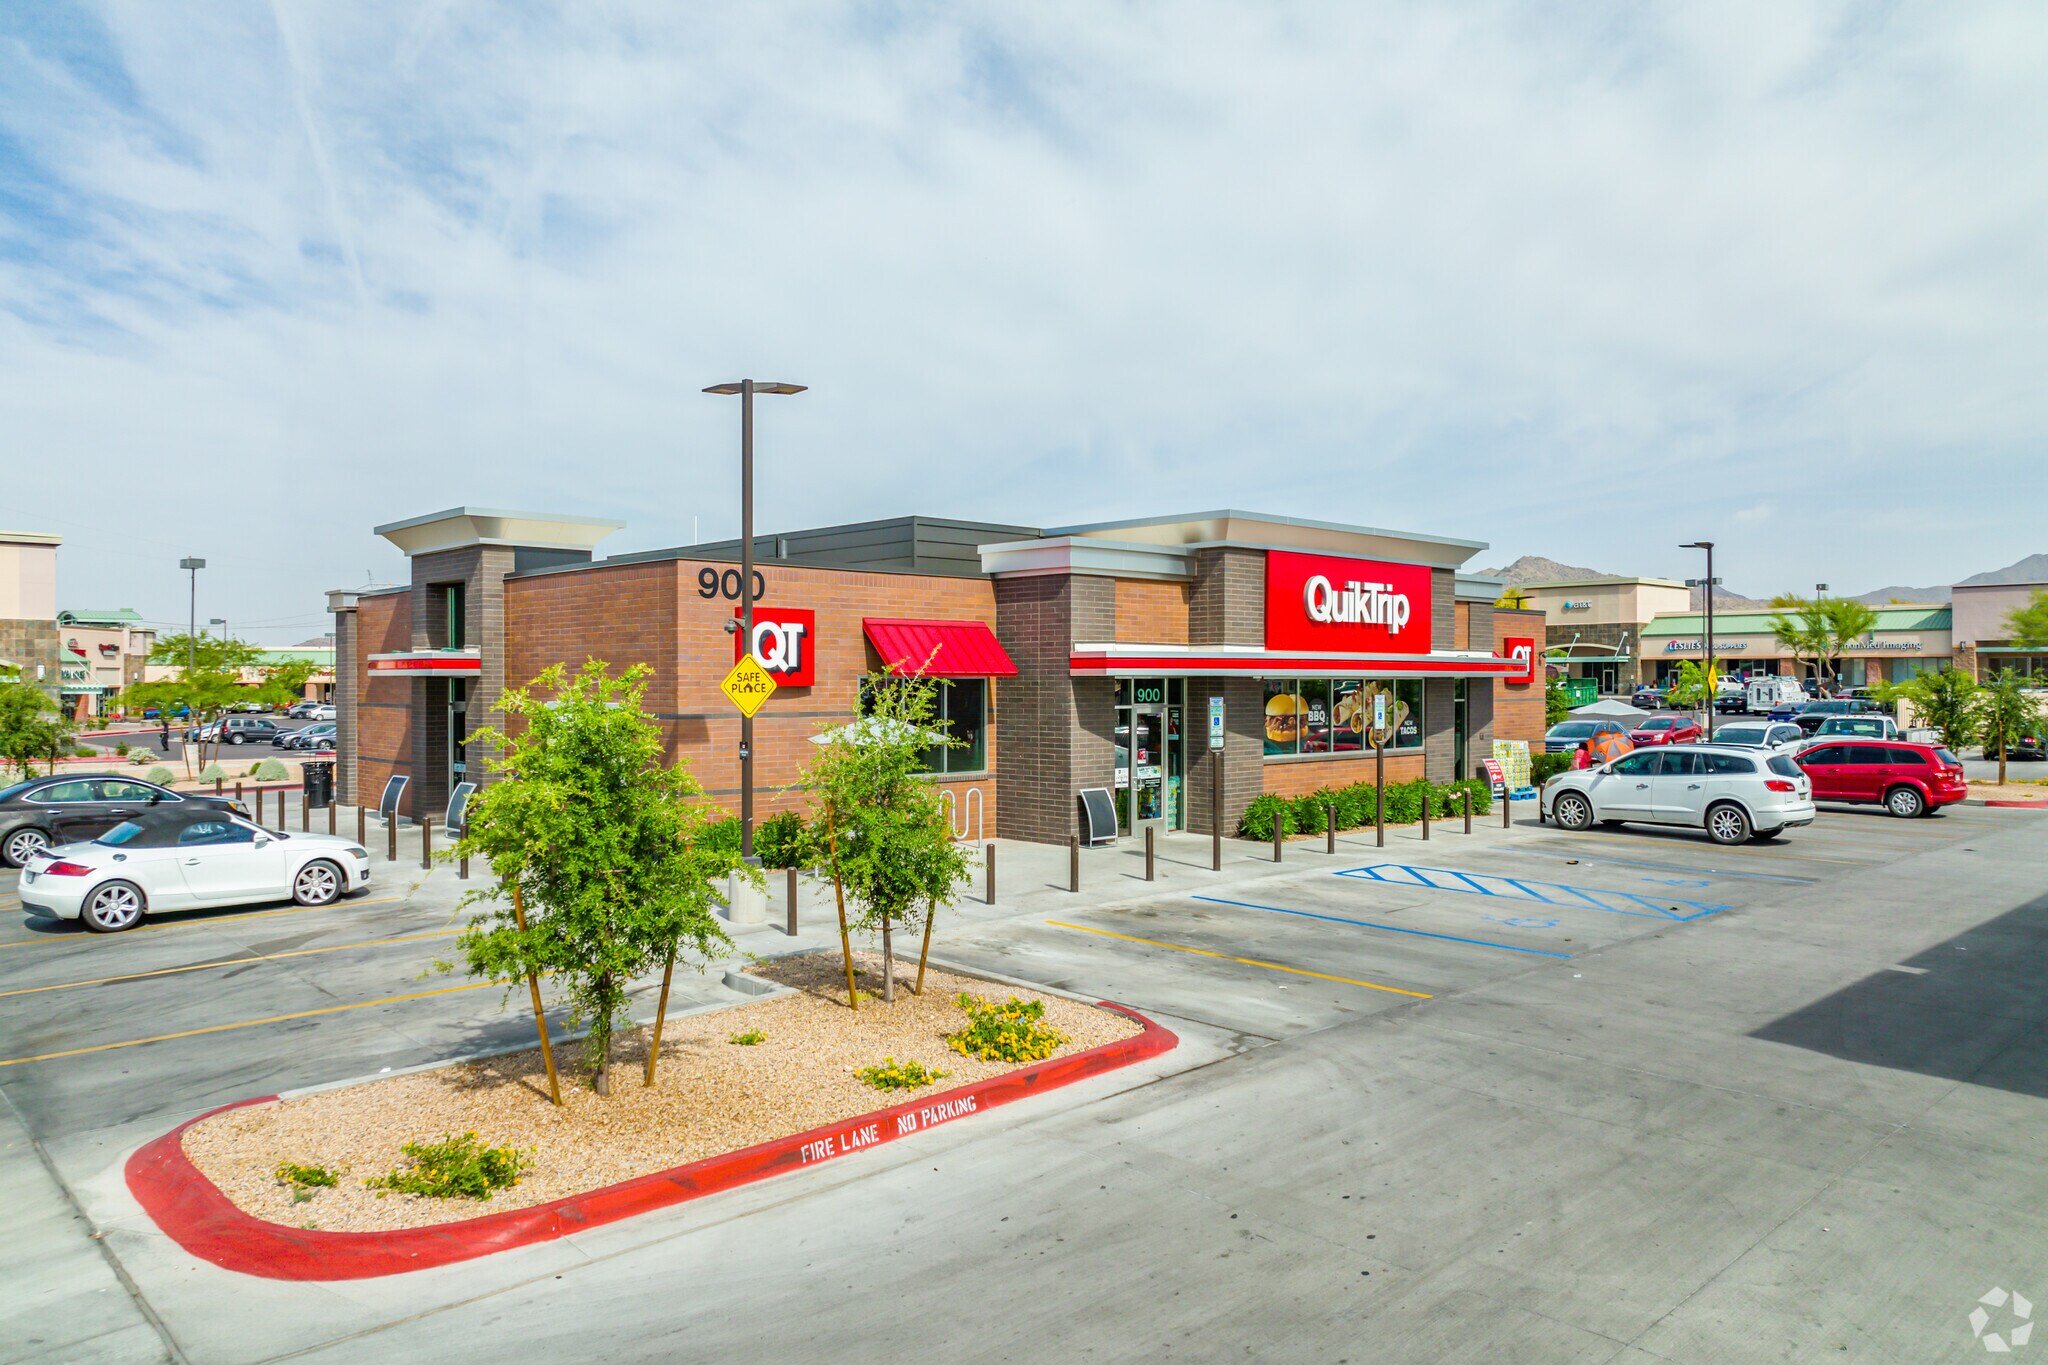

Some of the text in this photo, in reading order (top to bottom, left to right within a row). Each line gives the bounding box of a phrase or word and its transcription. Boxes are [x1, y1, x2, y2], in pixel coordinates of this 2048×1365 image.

[698, 567, 765, 601] 900
[1304, 575, 1410, 634] QuikTrip
[752, 621, 806, 674] QT
[1882, 640, 1922, 651] Imaging
[736, 673, 760, 682] SAFE
[1137, 688, 1160, 702] 900
[1308, 710, 1325, 723] BBQ
[1400, 726, 1417, 735] TACOS
[800, 1095, 977, 1163] FIRE LANE NO PARKING
